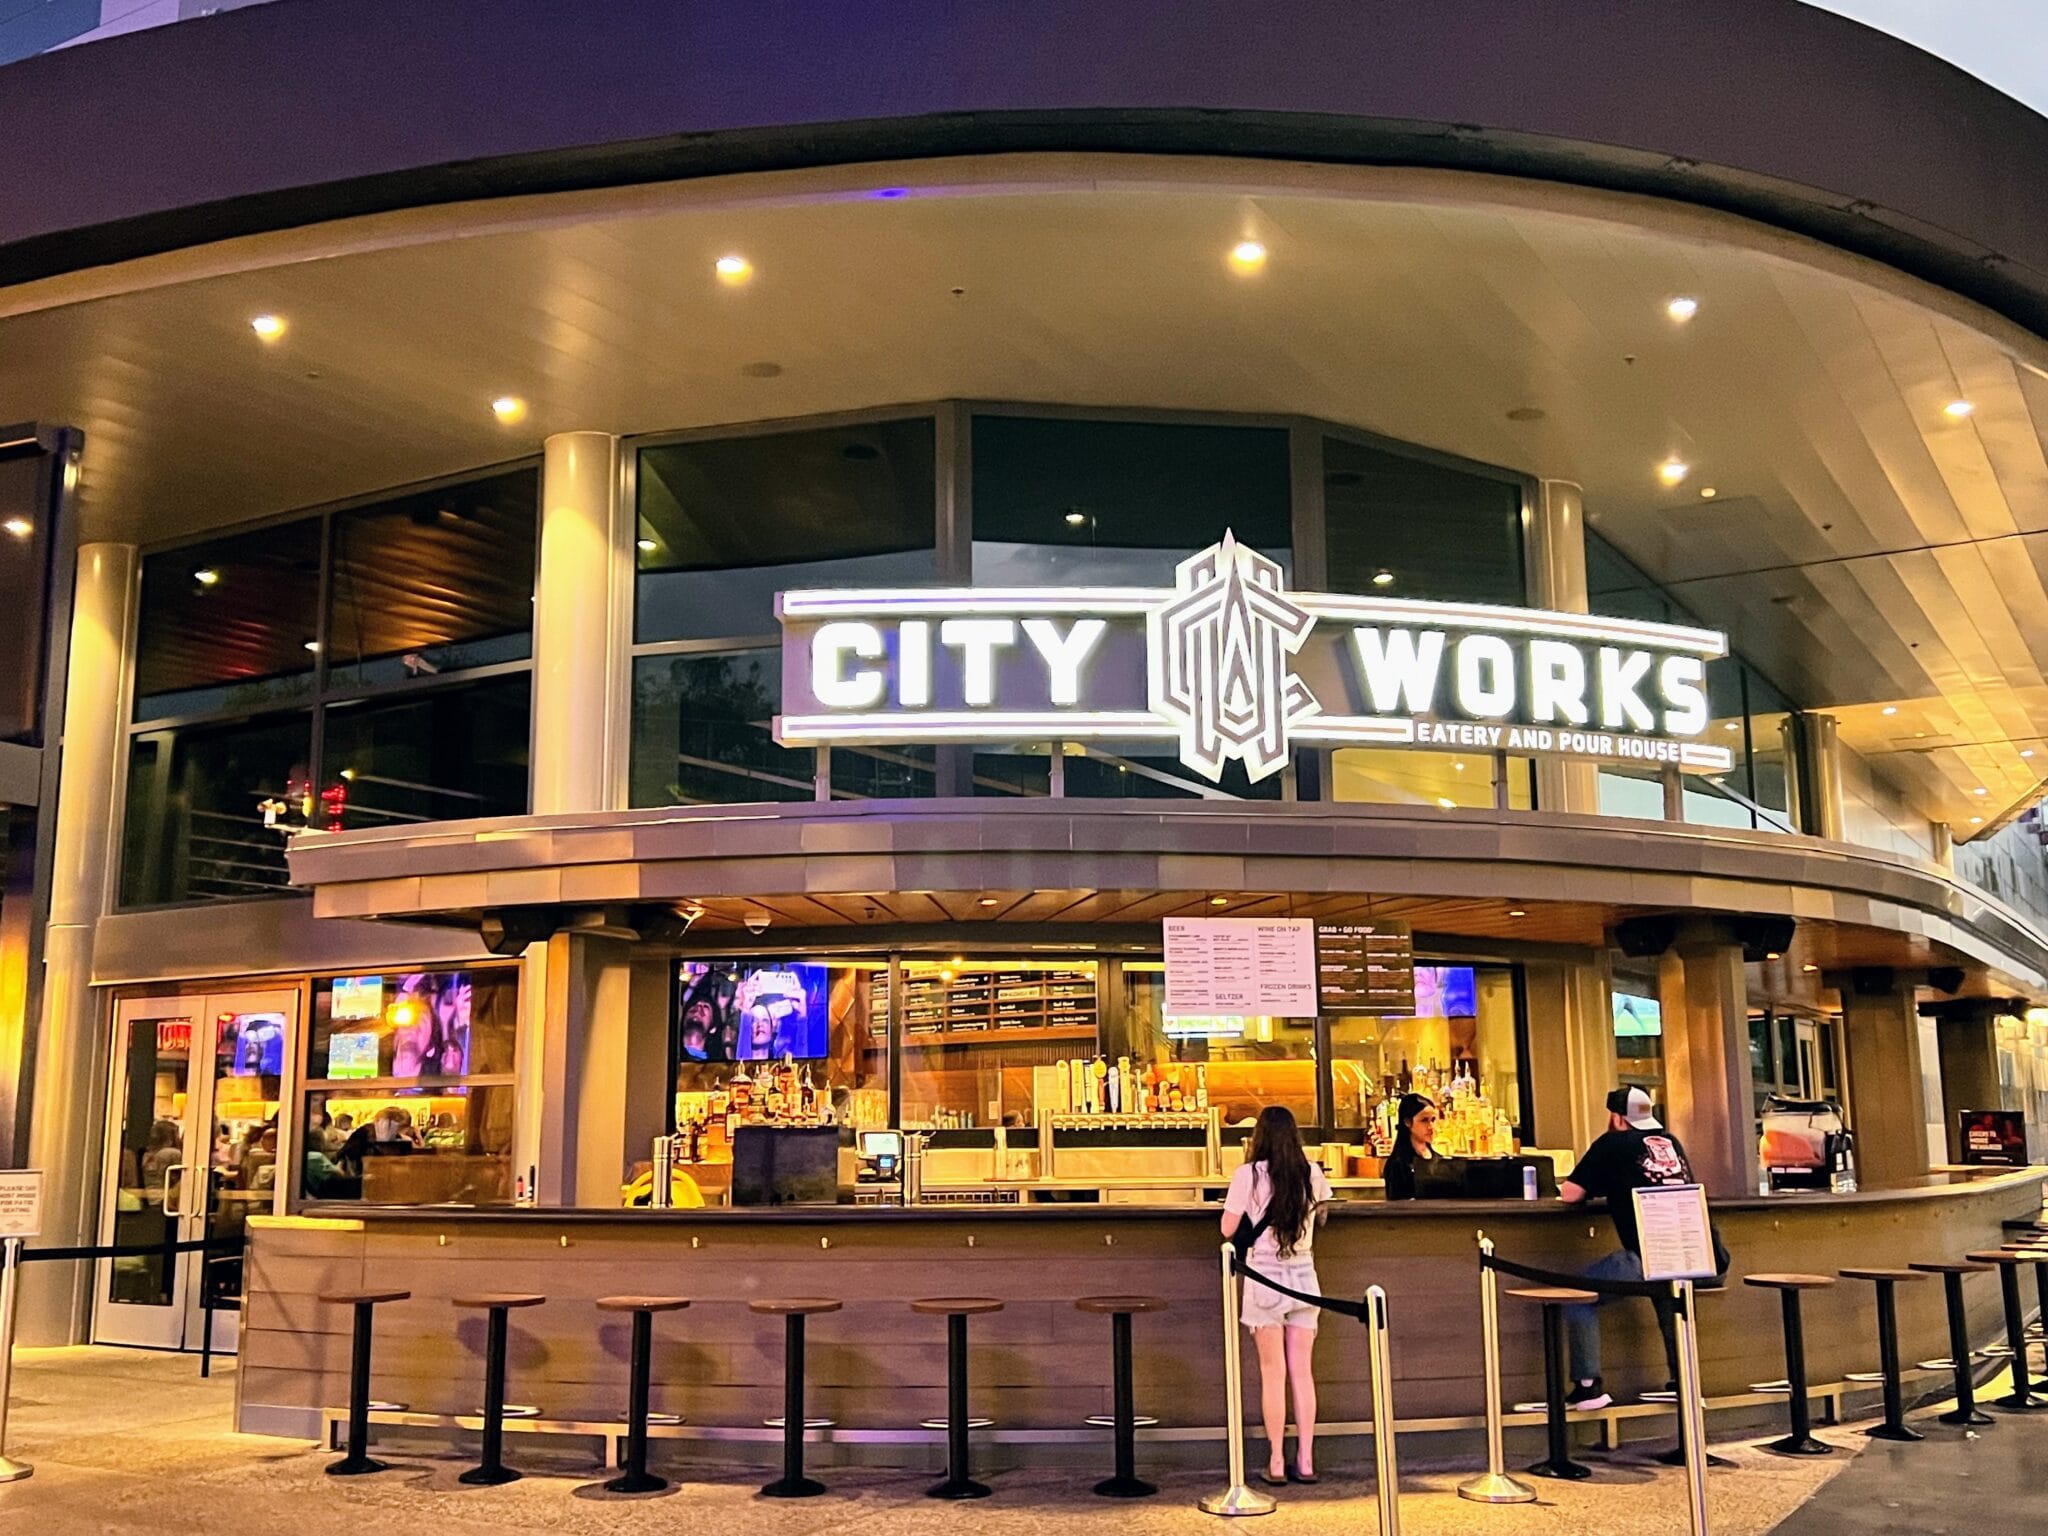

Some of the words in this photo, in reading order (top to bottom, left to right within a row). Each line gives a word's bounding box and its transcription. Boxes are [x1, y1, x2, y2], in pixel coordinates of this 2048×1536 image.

[812, 620, 1106, 707] CITY
[1353, 626, 1708, 735] WORKS
[1417, 722, 1502, 746] EATERY
[1508, 727, 1552, 750] AND
[1559, 732, 1613, 755] POUR
[1618, 737, 1682, 761] HOUSE
